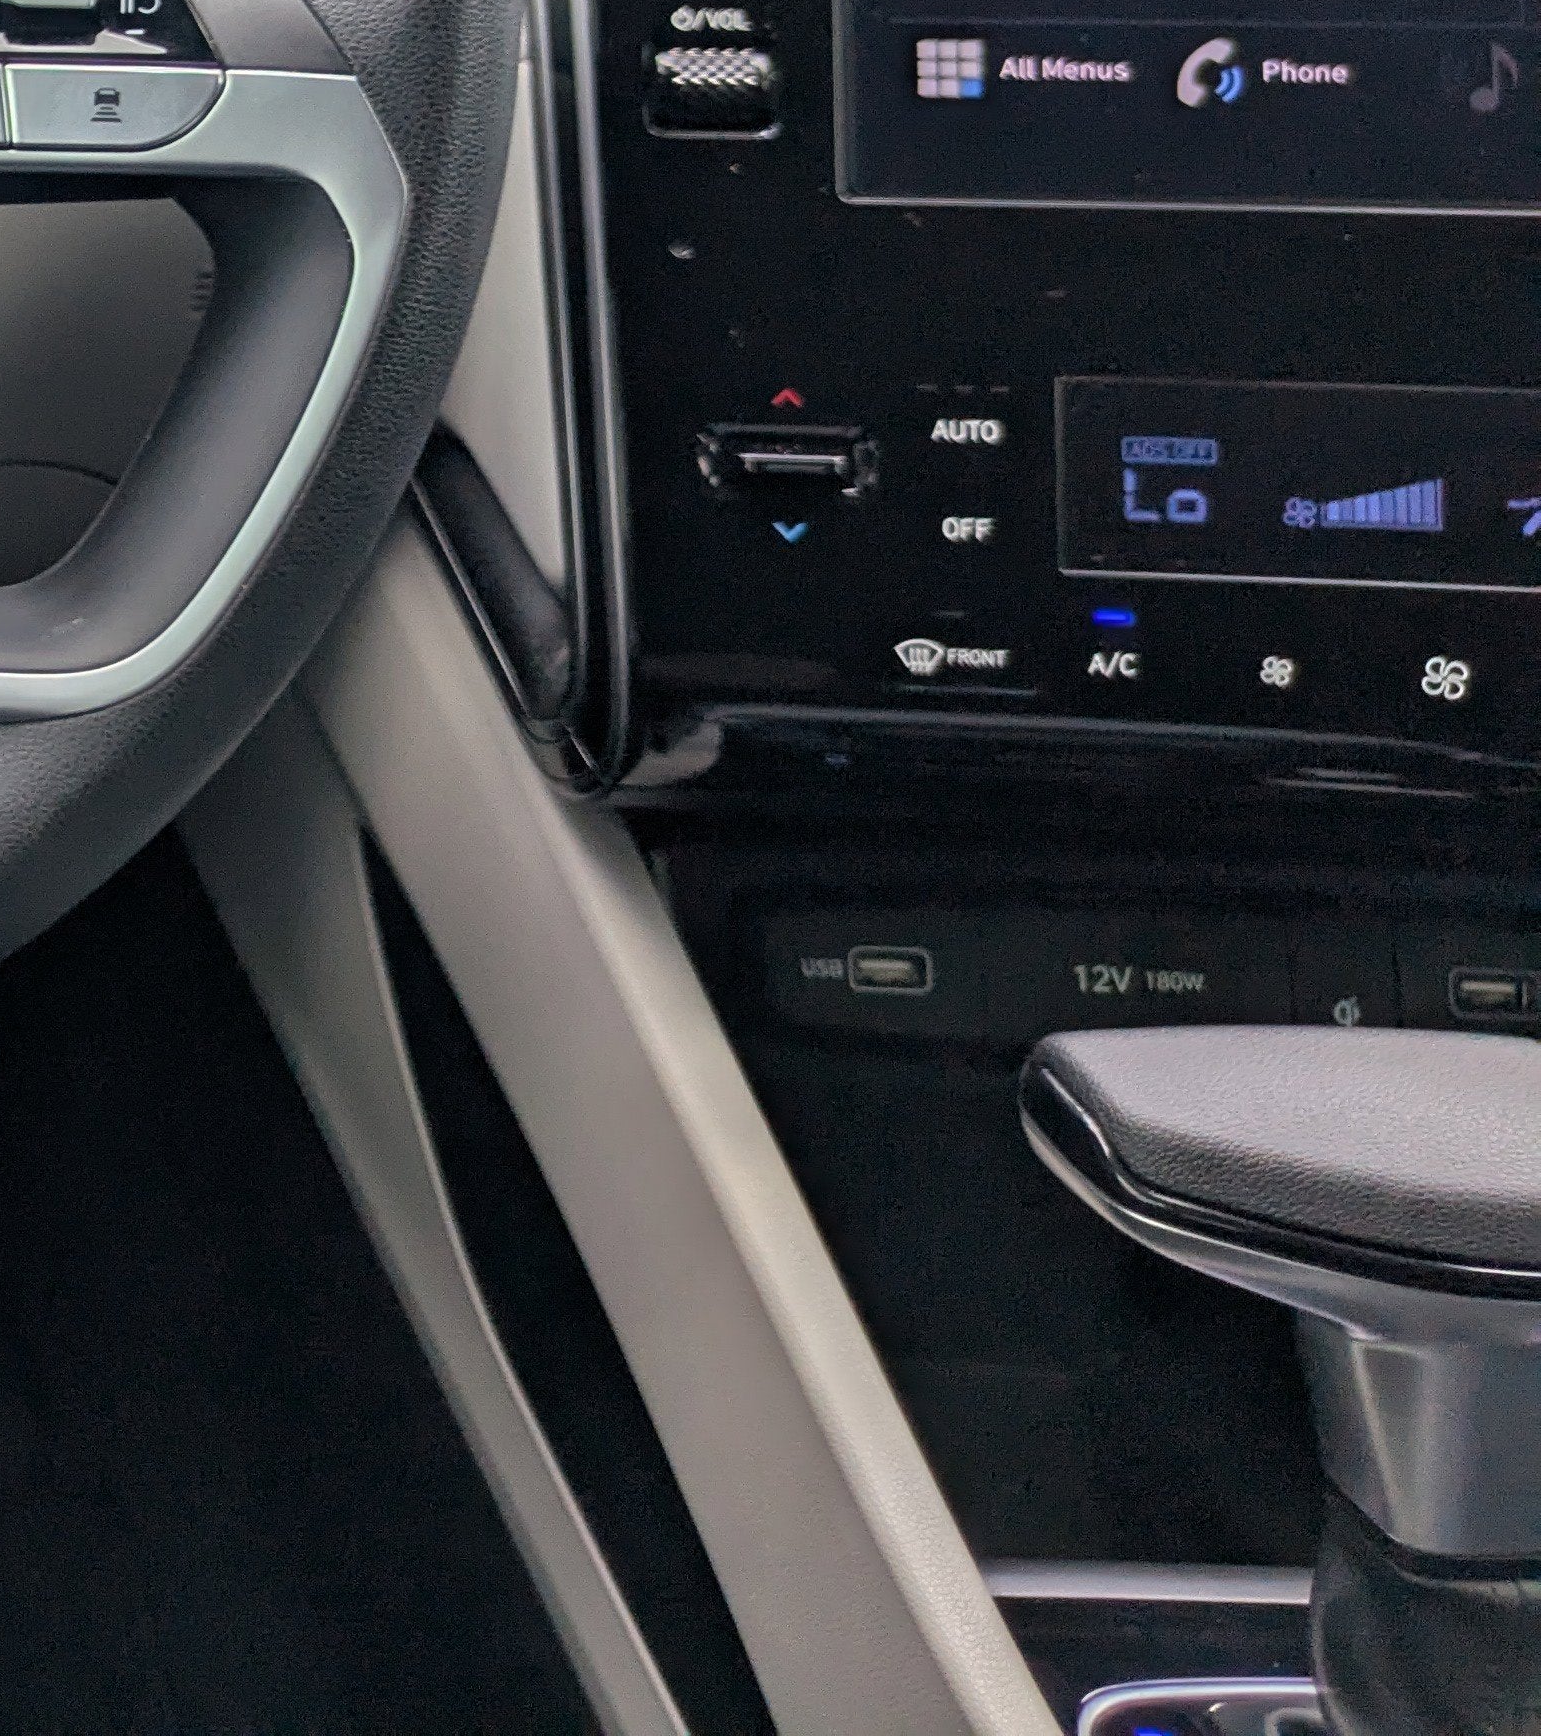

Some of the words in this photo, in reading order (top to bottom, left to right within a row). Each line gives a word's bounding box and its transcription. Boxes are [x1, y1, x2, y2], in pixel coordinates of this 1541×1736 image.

[999, 56, 1038, 81] All
[1041, 56, 1131, 82] Menus
[1261, 59, 1351, 85] Phone
[931, 418, 1005, 445] AUTO
[941, 516, 997, 543] OFF
[946, 646, 1012, 670] FRONT
[1087, 650, 1141, 679] A/C
[1073, 964, 1133, 994] 12V
[1145, 970, 1205, 994] 180W
